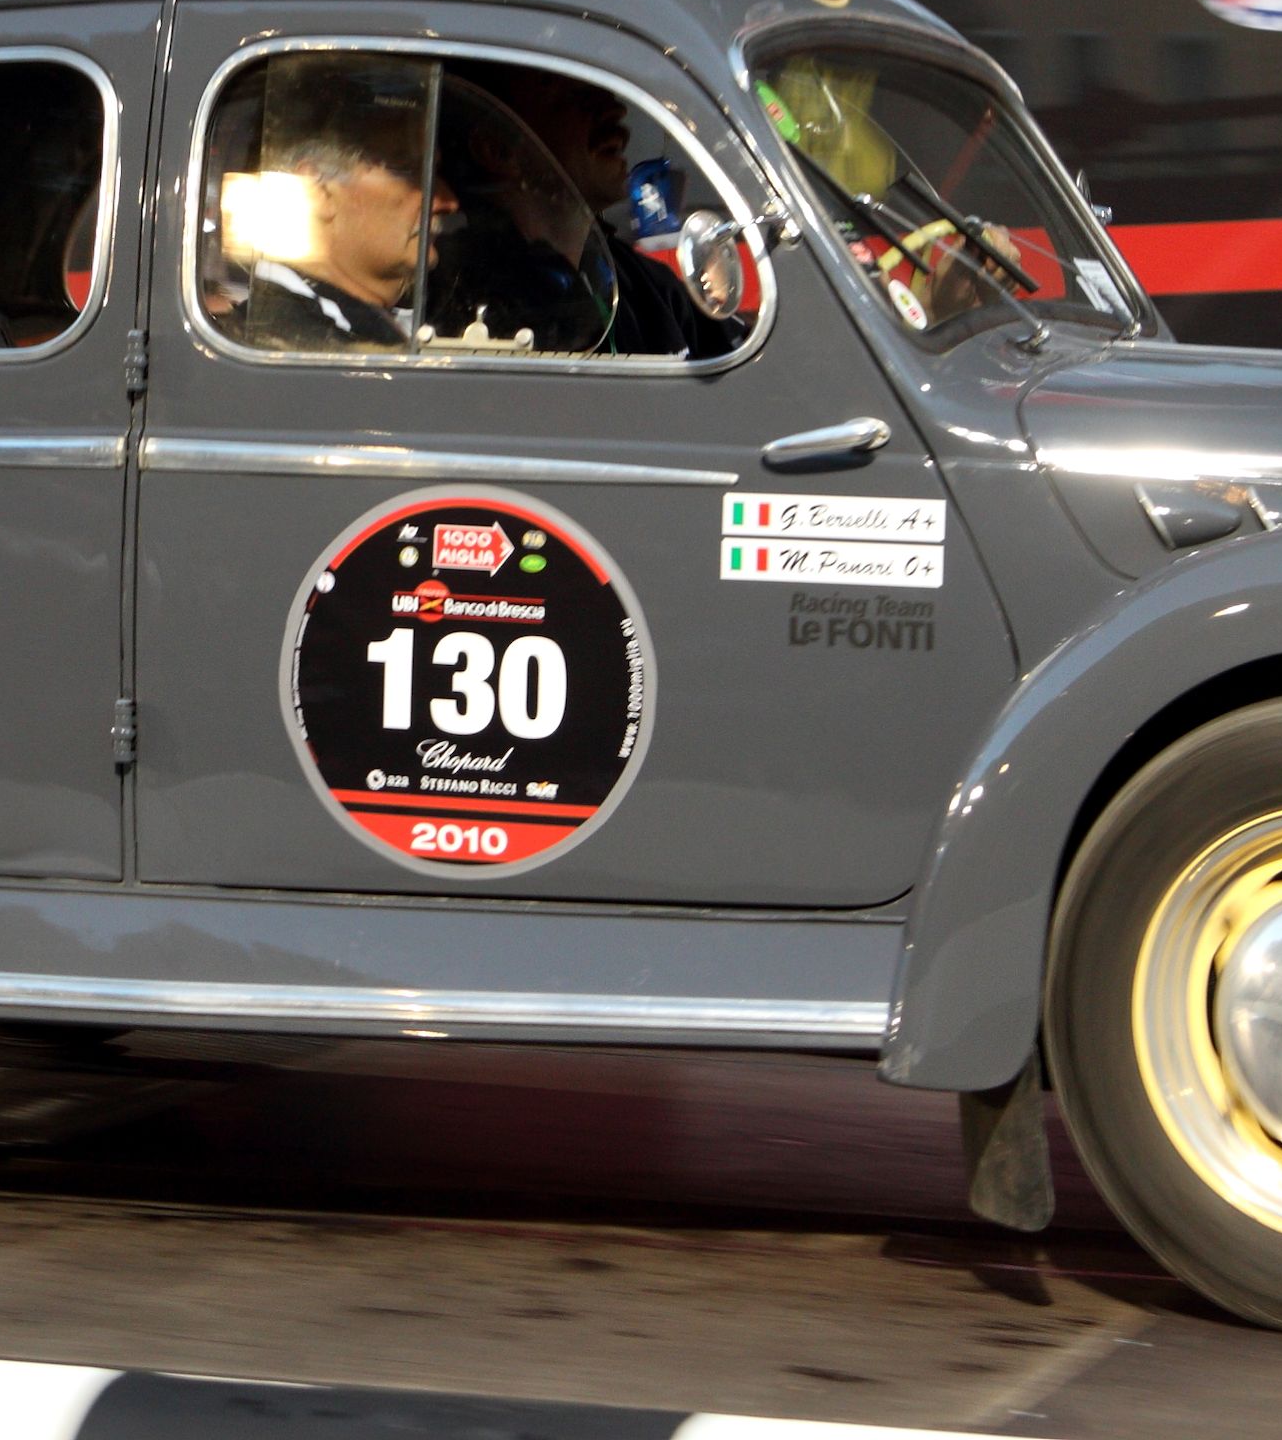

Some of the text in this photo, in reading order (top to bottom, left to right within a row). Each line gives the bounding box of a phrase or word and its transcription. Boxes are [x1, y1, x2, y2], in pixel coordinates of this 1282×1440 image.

[442, 530, 492, 548] 1000
[437, 547, 496, 567] MIGLIA
[391, 594, 419, 613] UBI
[789, 592, 936, 619] Racing Team
[826, 617, 937, 652] FONTI
[367, 627, 568, 740] 130
[416, 738, 515, 774] Chopard
[420, 774, 480, 794] STEFANO
[479, 778, 519, 796] RICCI
[410, 821, 509, 856] 2010
